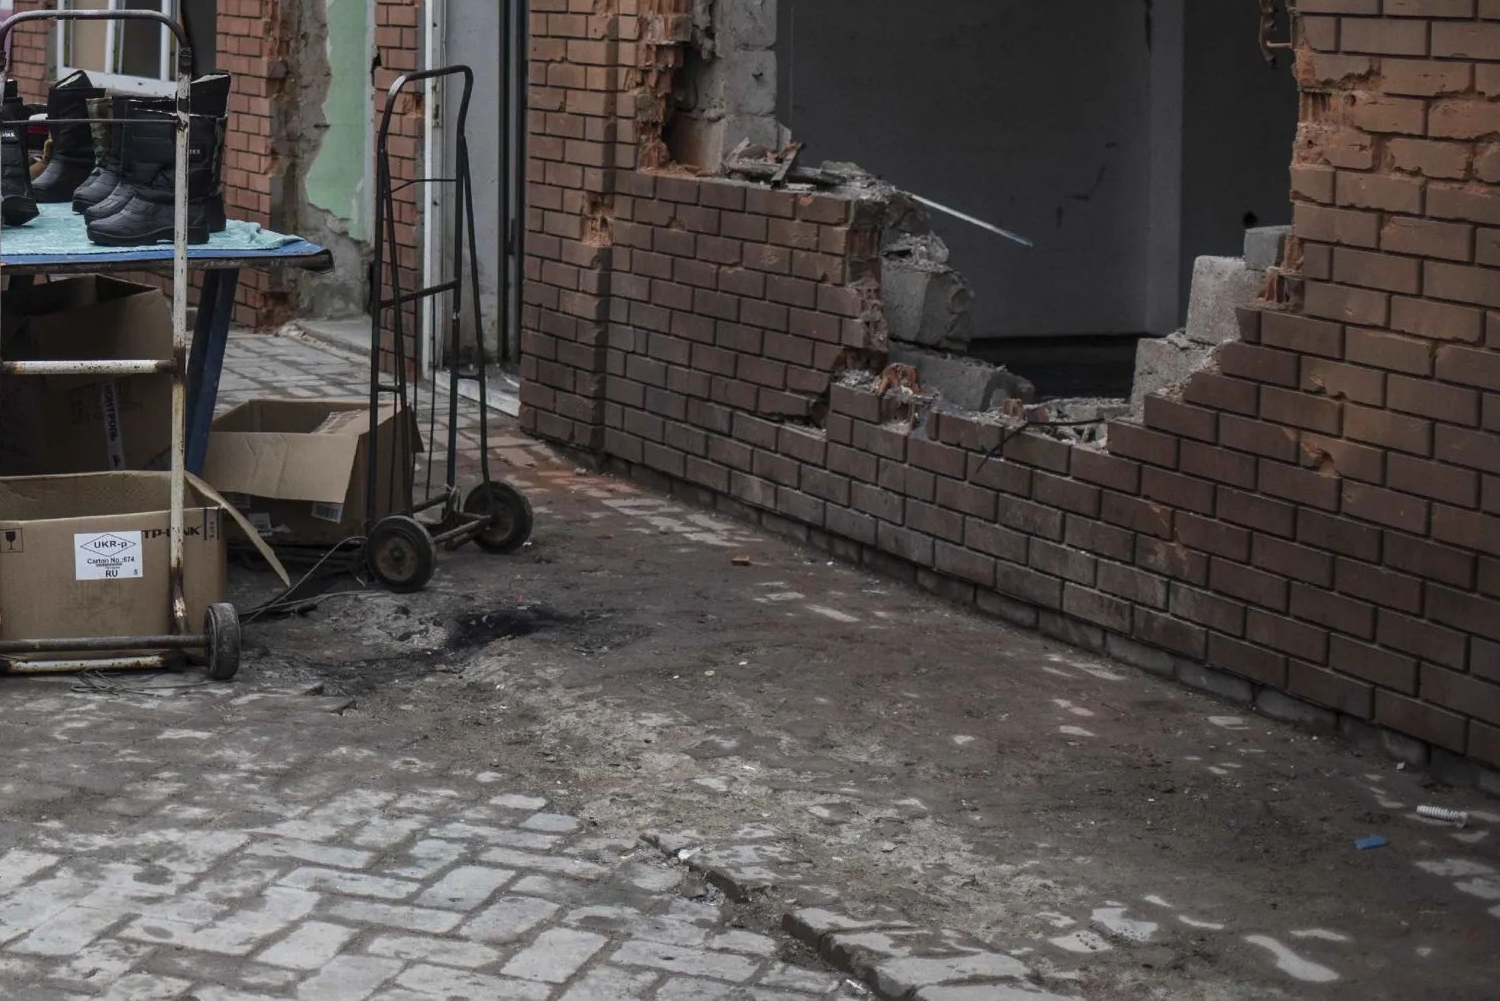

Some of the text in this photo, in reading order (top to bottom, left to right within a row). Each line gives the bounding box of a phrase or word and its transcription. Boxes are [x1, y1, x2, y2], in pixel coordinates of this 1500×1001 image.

[142, 526, 201, 539] TP-LNK
[94, 540, 128, 549] UKR-p
[87, 557, 109, 565] Carton
[105, 569, 119, 578] RU
